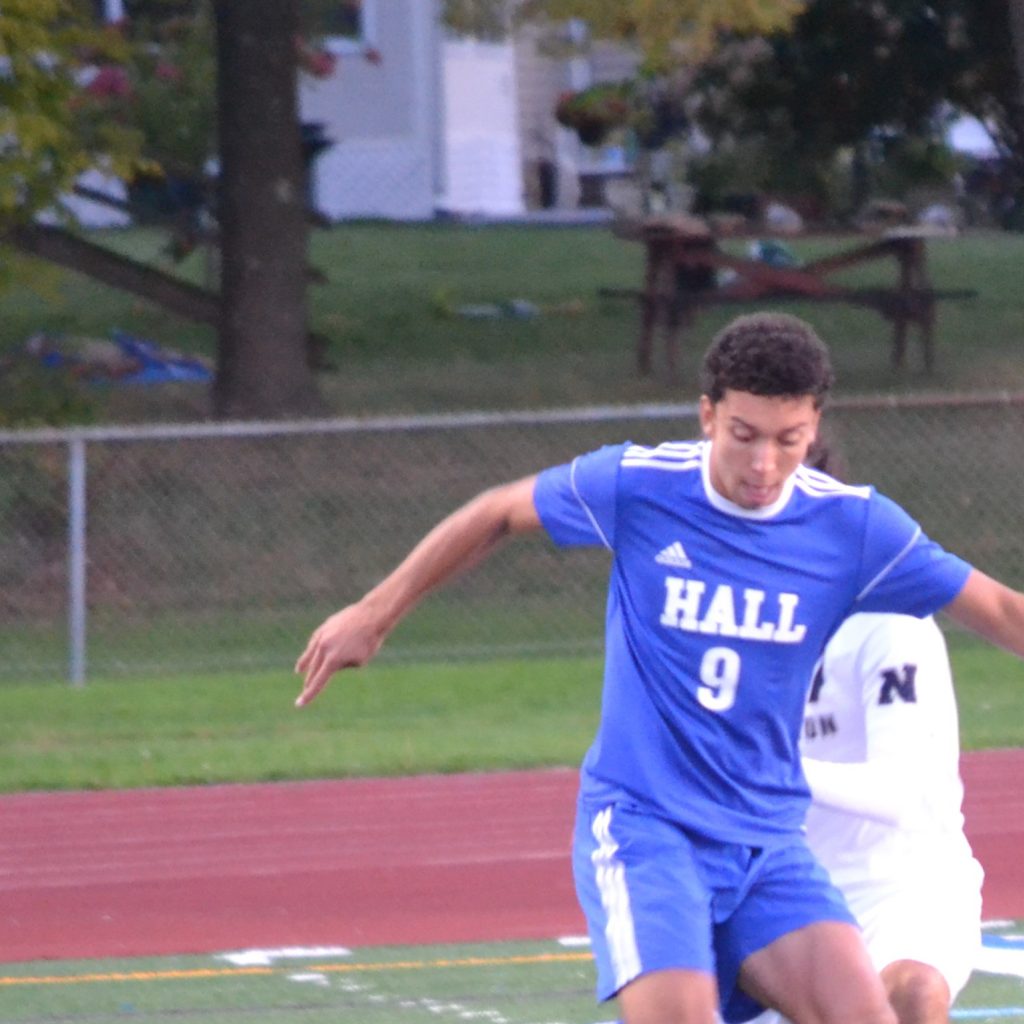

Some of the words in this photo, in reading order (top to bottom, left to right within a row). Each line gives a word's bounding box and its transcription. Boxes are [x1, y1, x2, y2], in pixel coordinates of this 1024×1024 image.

[660, 576, 807, 642] HALL
[697, 647, 741, 711] 9
[878, 663, 918, 705] N
